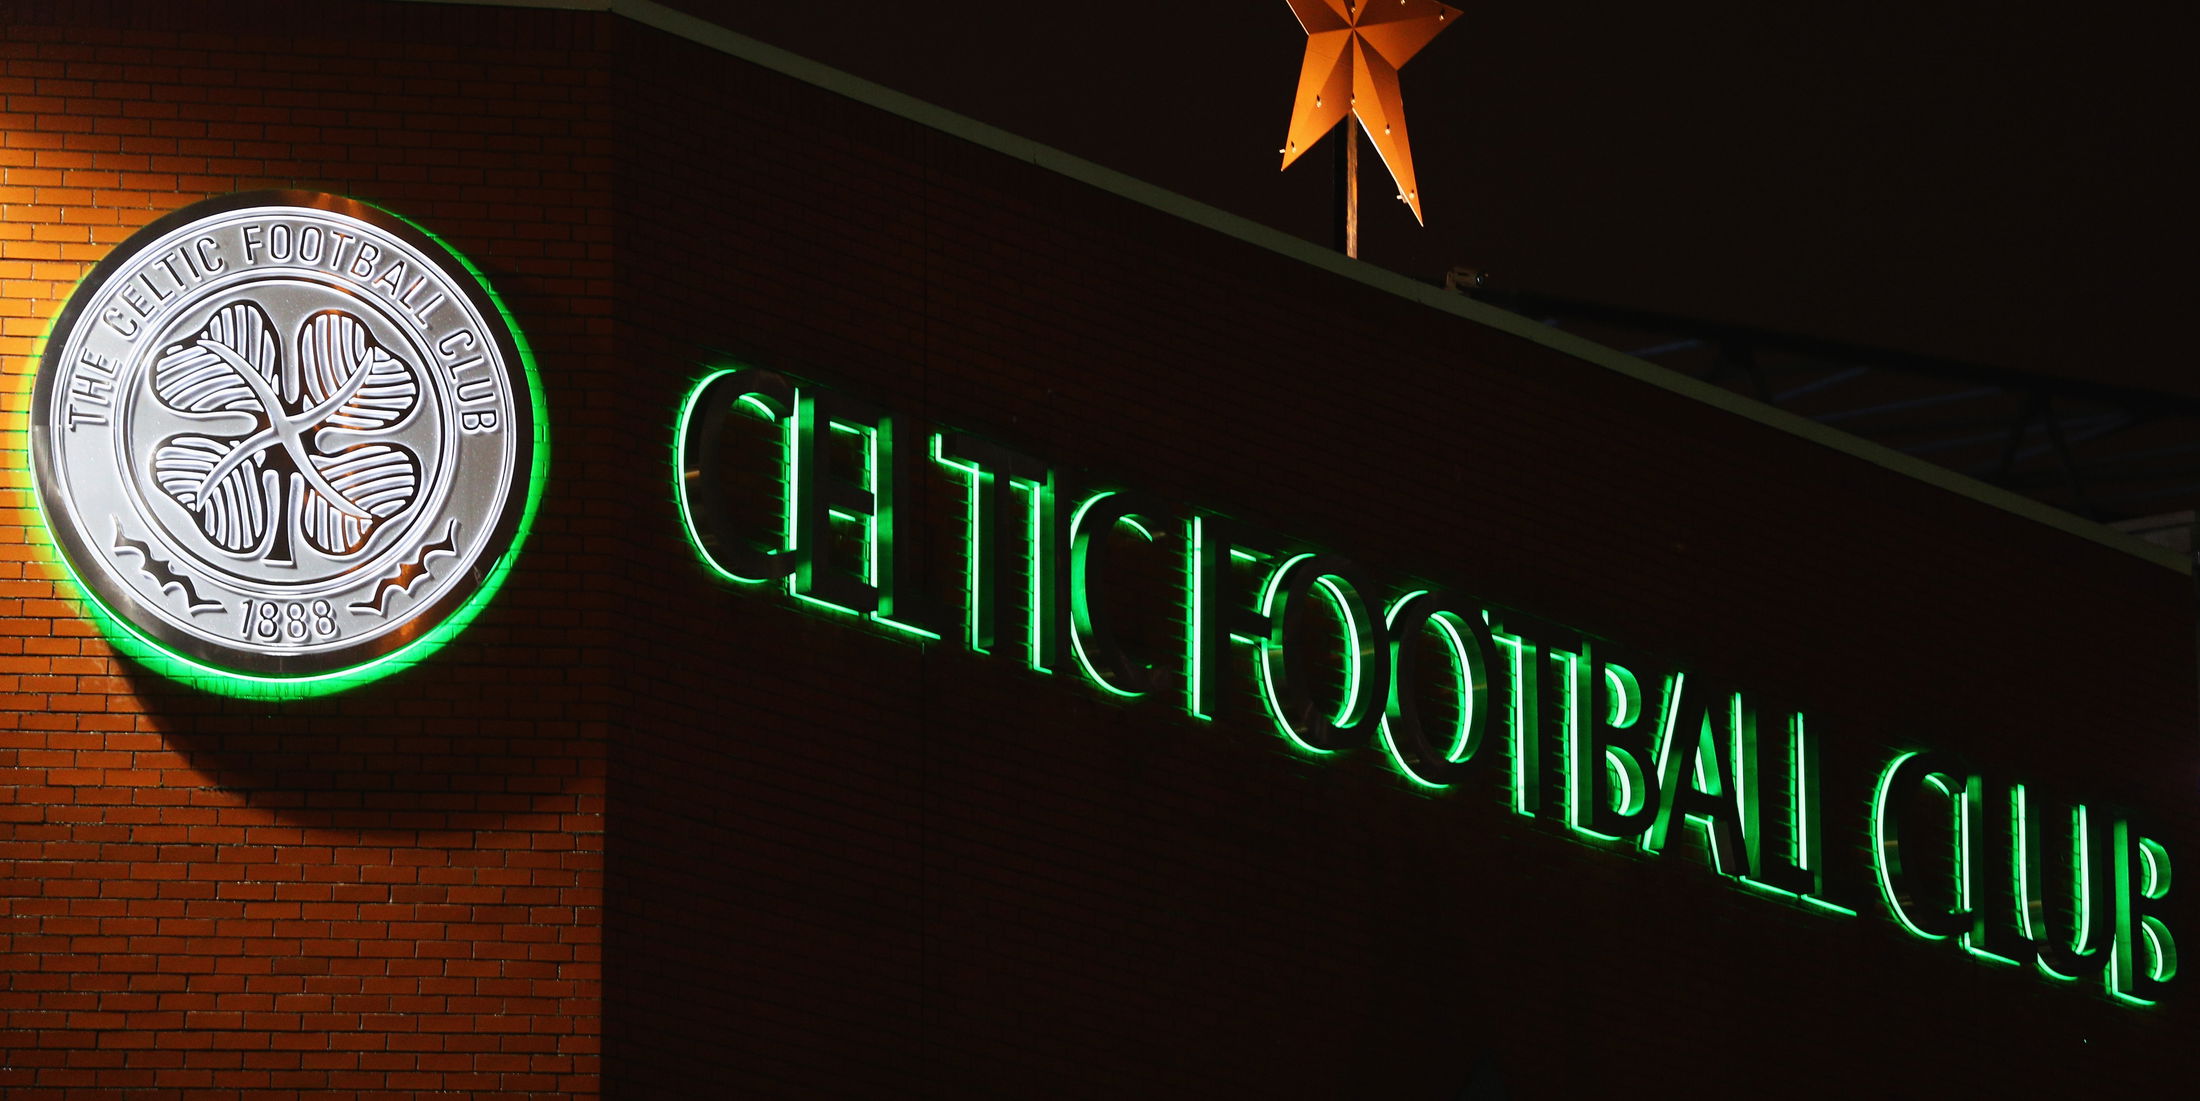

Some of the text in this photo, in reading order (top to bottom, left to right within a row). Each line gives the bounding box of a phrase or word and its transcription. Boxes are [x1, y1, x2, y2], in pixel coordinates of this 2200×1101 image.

[69, 222, 498, 436] THE CELTIC FOOTBALL CLUB
[239, 597, 339, 641] 1888
[674, 366, 2180, 1007] CELTIC FOOTBALL CLUB
